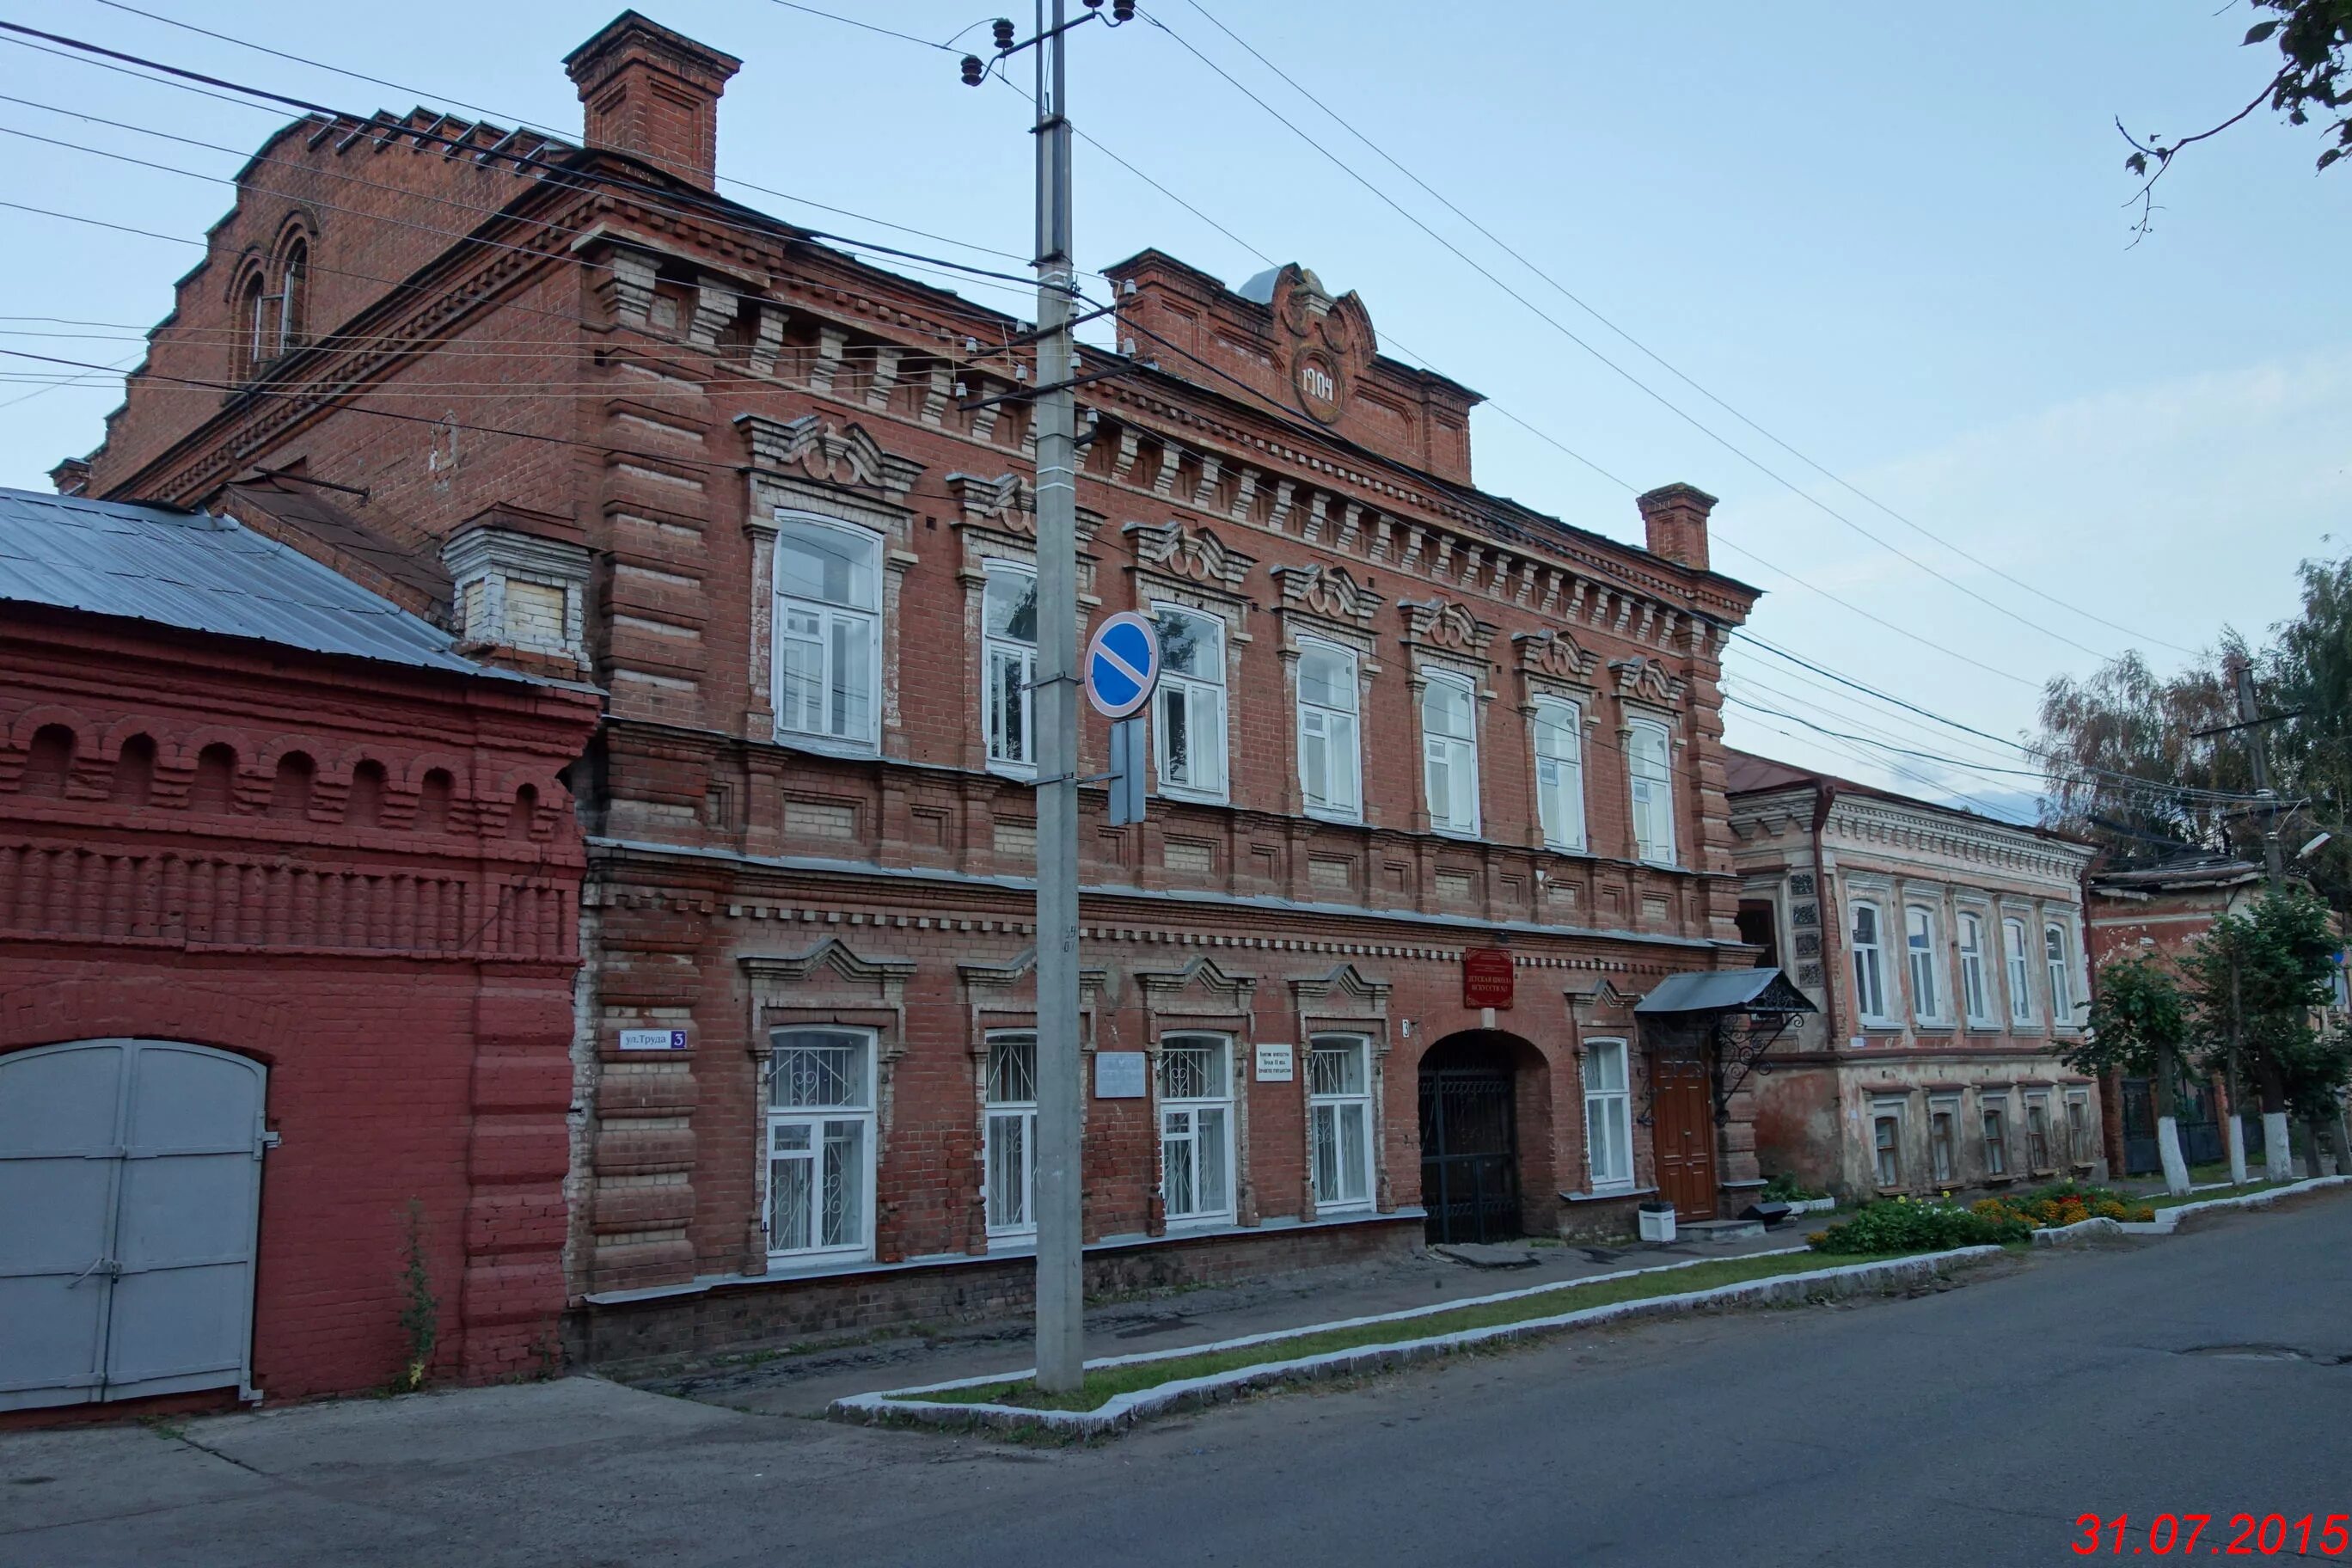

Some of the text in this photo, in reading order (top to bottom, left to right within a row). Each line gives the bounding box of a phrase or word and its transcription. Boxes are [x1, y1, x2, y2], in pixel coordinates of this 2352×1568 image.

[1302, 368, 1332, 401] 1904
[1404, 1020, 1409, 1037] 3
[673, 1033, 684, 1046] 3
